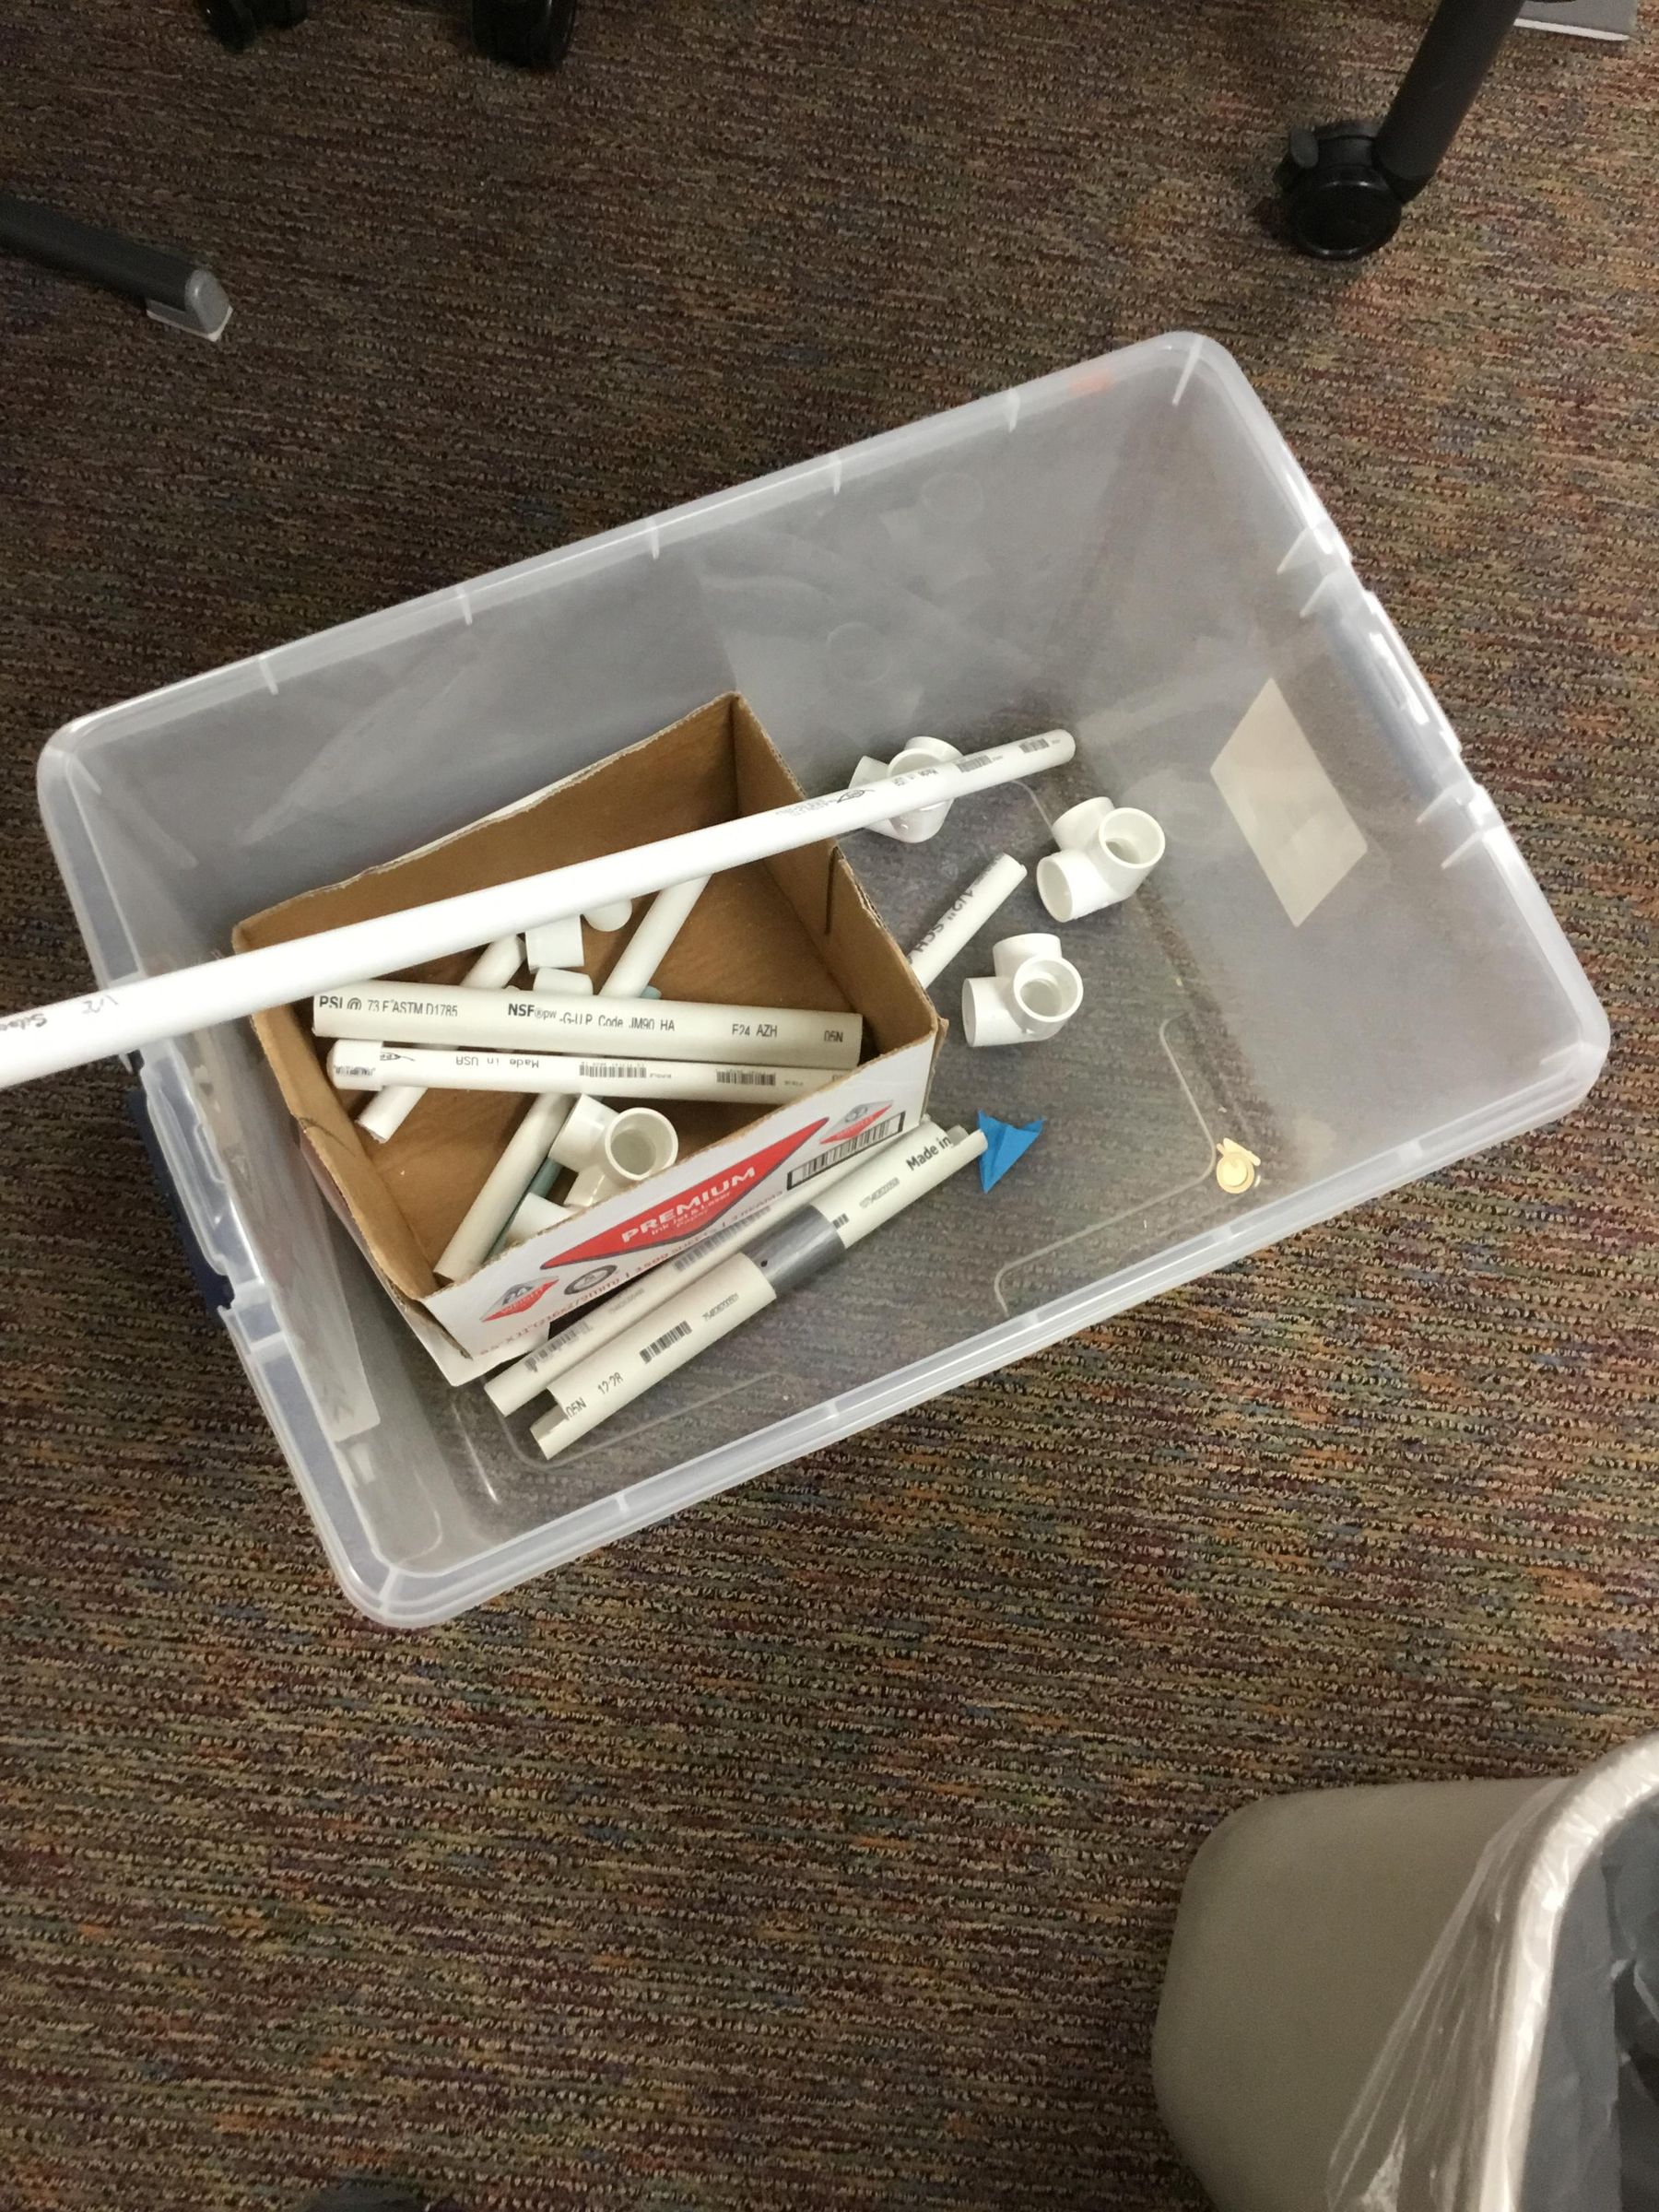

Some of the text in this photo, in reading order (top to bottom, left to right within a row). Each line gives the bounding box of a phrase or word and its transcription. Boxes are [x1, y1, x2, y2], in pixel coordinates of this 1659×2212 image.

[319, 994, 344, 1009] PSI
[598, 1015, 624, 1028] Code
[660, 1018, 676, 1031] HA
[756, 1023, 778, 1038] AZH
[455, 1055, 540, 1068] Made in USA
[905, 1135, 952, 1171] Made in
[621, 1166, 757, 1243] PREMIUM
